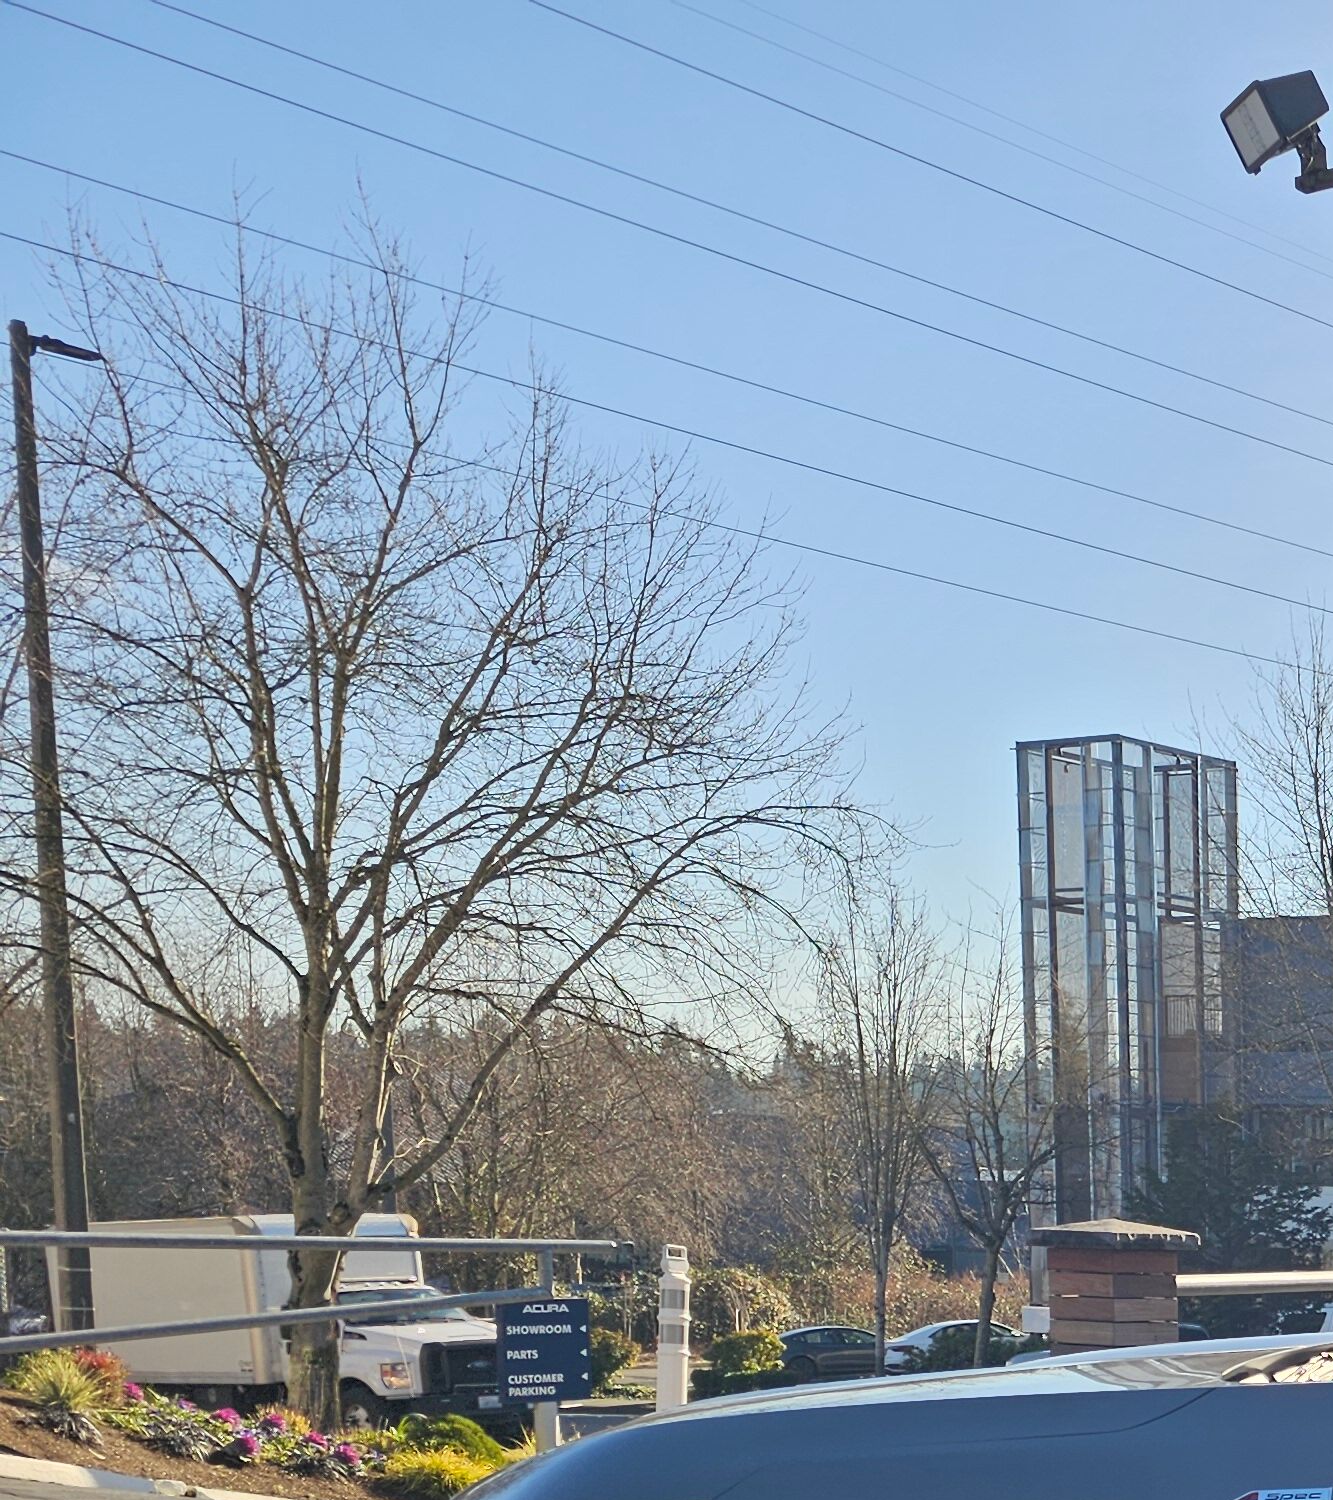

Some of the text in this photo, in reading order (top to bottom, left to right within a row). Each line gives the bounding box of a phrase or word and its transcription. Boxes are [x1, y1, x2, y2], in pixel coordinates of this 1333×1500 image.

[522, 1303, 570, 1314] ACURA
[506, 1324, 572, 1335] SHOWROOM
[506, 1350, 539, 1360] PARTS
[508, 1373, 564, 1385] CUSTOMER
[508, 1386, 556, 1397] PARKING
